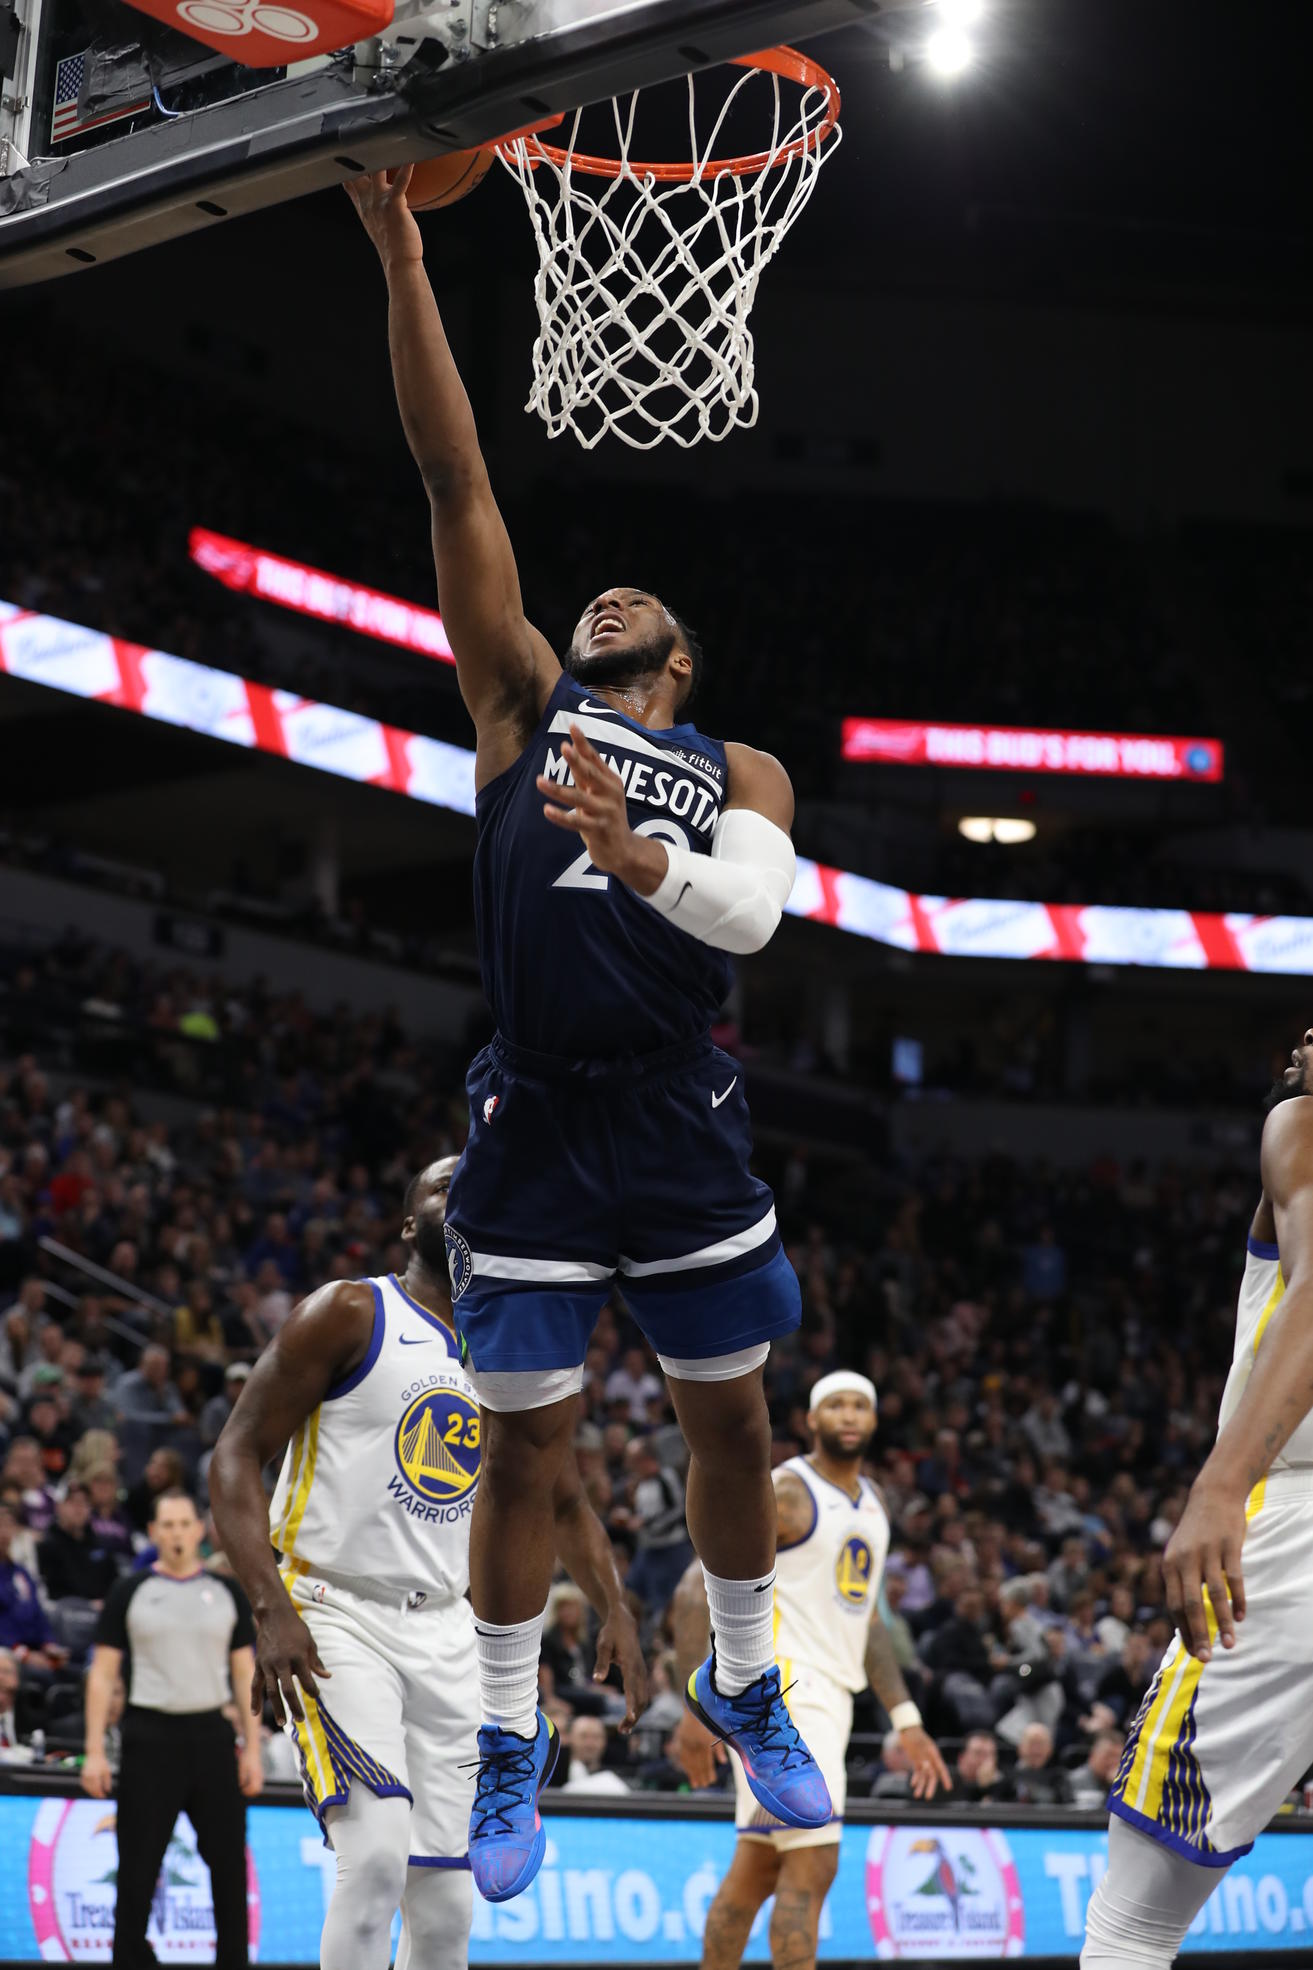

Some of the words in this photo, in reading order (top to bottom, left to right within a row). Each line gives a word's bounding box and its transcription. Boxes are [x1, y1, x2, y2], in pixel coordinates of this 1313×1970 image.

[688, 754, 723, 779] fitbit
[543, 747, 719, 838] MNESOTA
[401, 1375, 458, 1401] GOLDEN
[443, 1412, 481, 1449] 23
